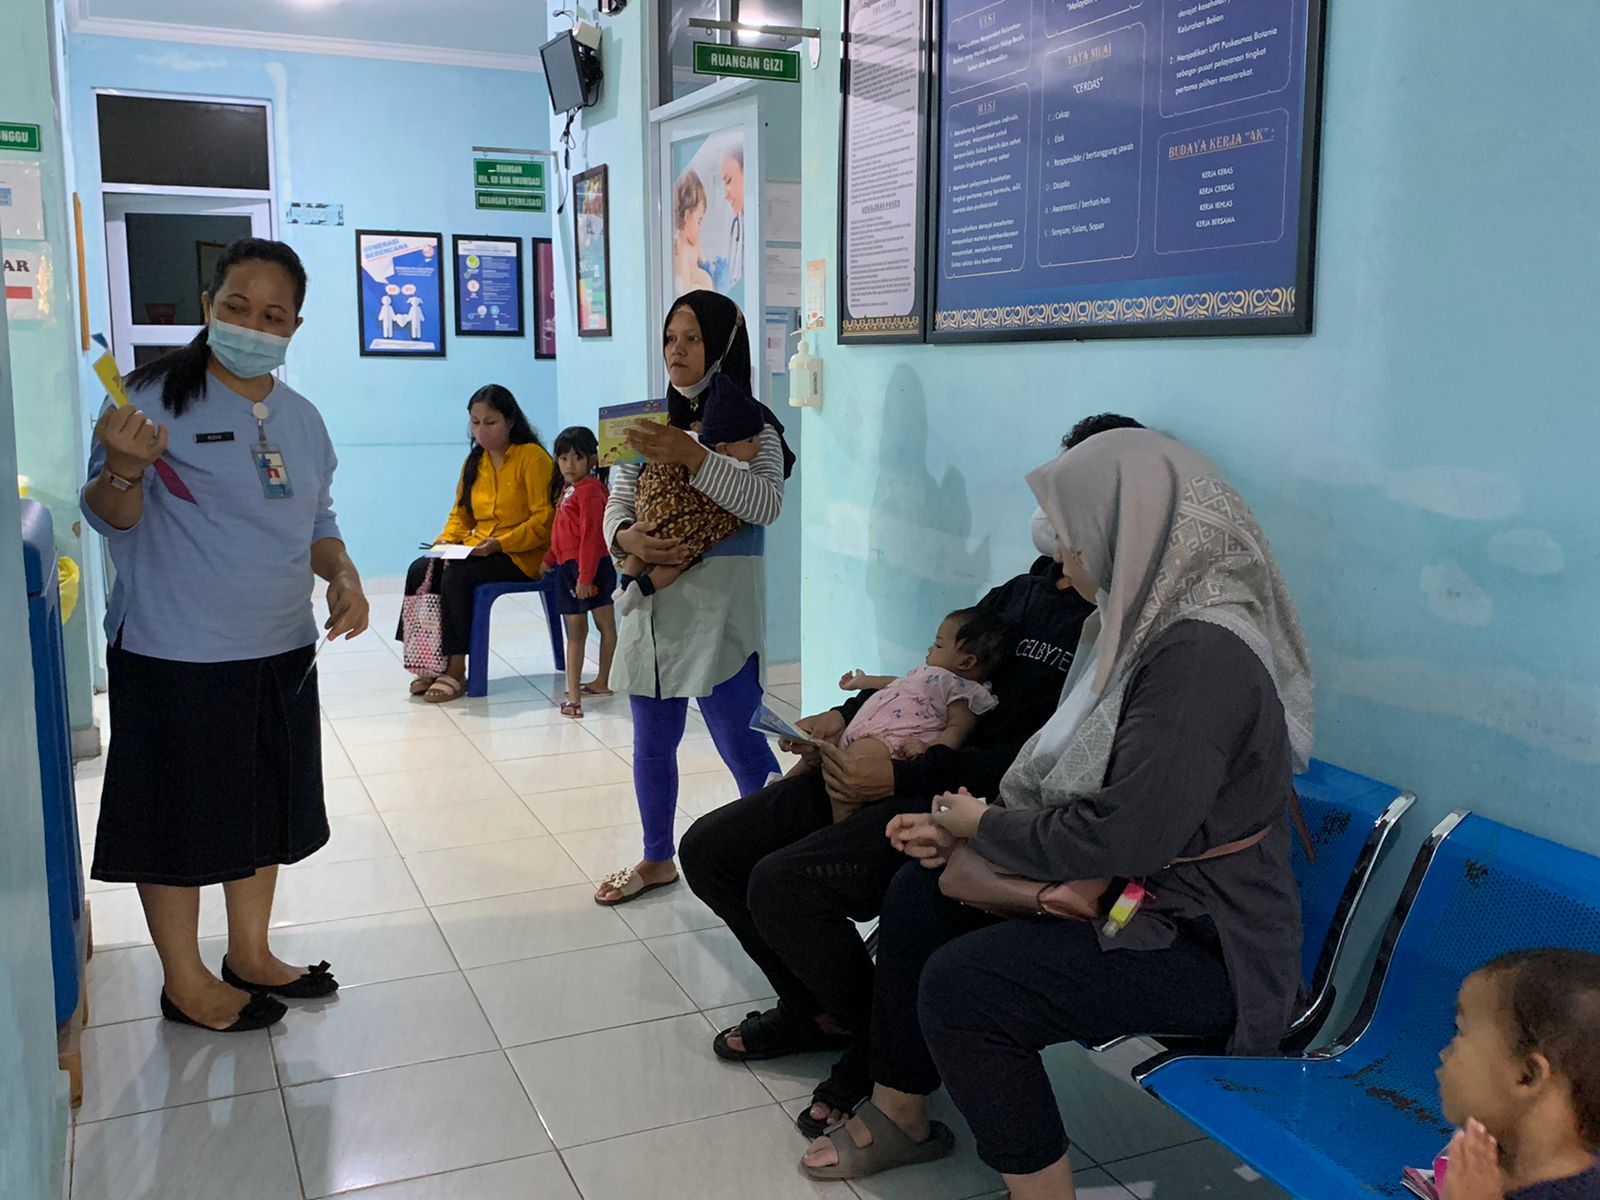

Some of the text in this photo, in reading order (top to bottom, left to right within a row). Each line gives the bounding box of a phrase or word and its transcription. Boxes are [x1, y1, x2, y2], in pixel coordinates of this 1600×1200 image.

[979, 12, 996, 27] VISI
[1177, 14, 1224, 34] Kelurahan Belian
[1176, 47, 1208, 62] Menjadikan
[1209, 42, 1220, 53] UPT
[1221, 34, 1253, 49] Puskesmas
[710, 53, 784, 72] RUANGAN GIZI
[1068, 50, 1088, 67] TATA
[1198, 62, 1213, 74] pusat
[1245, 47, 1266, 59] tingkat
[1073, 77, 1104, 94] "CERDAS"
[1175, 83, 1198, 96] pertama
[1198, 78, 1218, 90] pilihan
[977, 99, 996, 115] MISI
[0, 131, 29, 144] NGGU
[1009, 137, 1022, 146] sehat
[1085, 147, 1117, 160] bertanggung
[1117, 142, 1134, 155] jawab
[1168, 139, 1207, 159] BUDAYA
[1209, 132, 1243, 150] KERJA
[987, 156, 998, 165] yang
[496, 164, 523, 174] RUANGAN
[1201, 166, 1234, 179] KERJA KERAS
[499, 175, 511, 184] DAN
[1199, 182, 1235, 195] KERJA CERDAS
[479, 195, 542, 207] RUANGAN STERILISASI
[1199, 199, 1233, 211] KERJA IKHLAS
[1088, 222, 1105, 232] Sopan
[1195, 216, 1236, 228] KERJA BERSAMA
